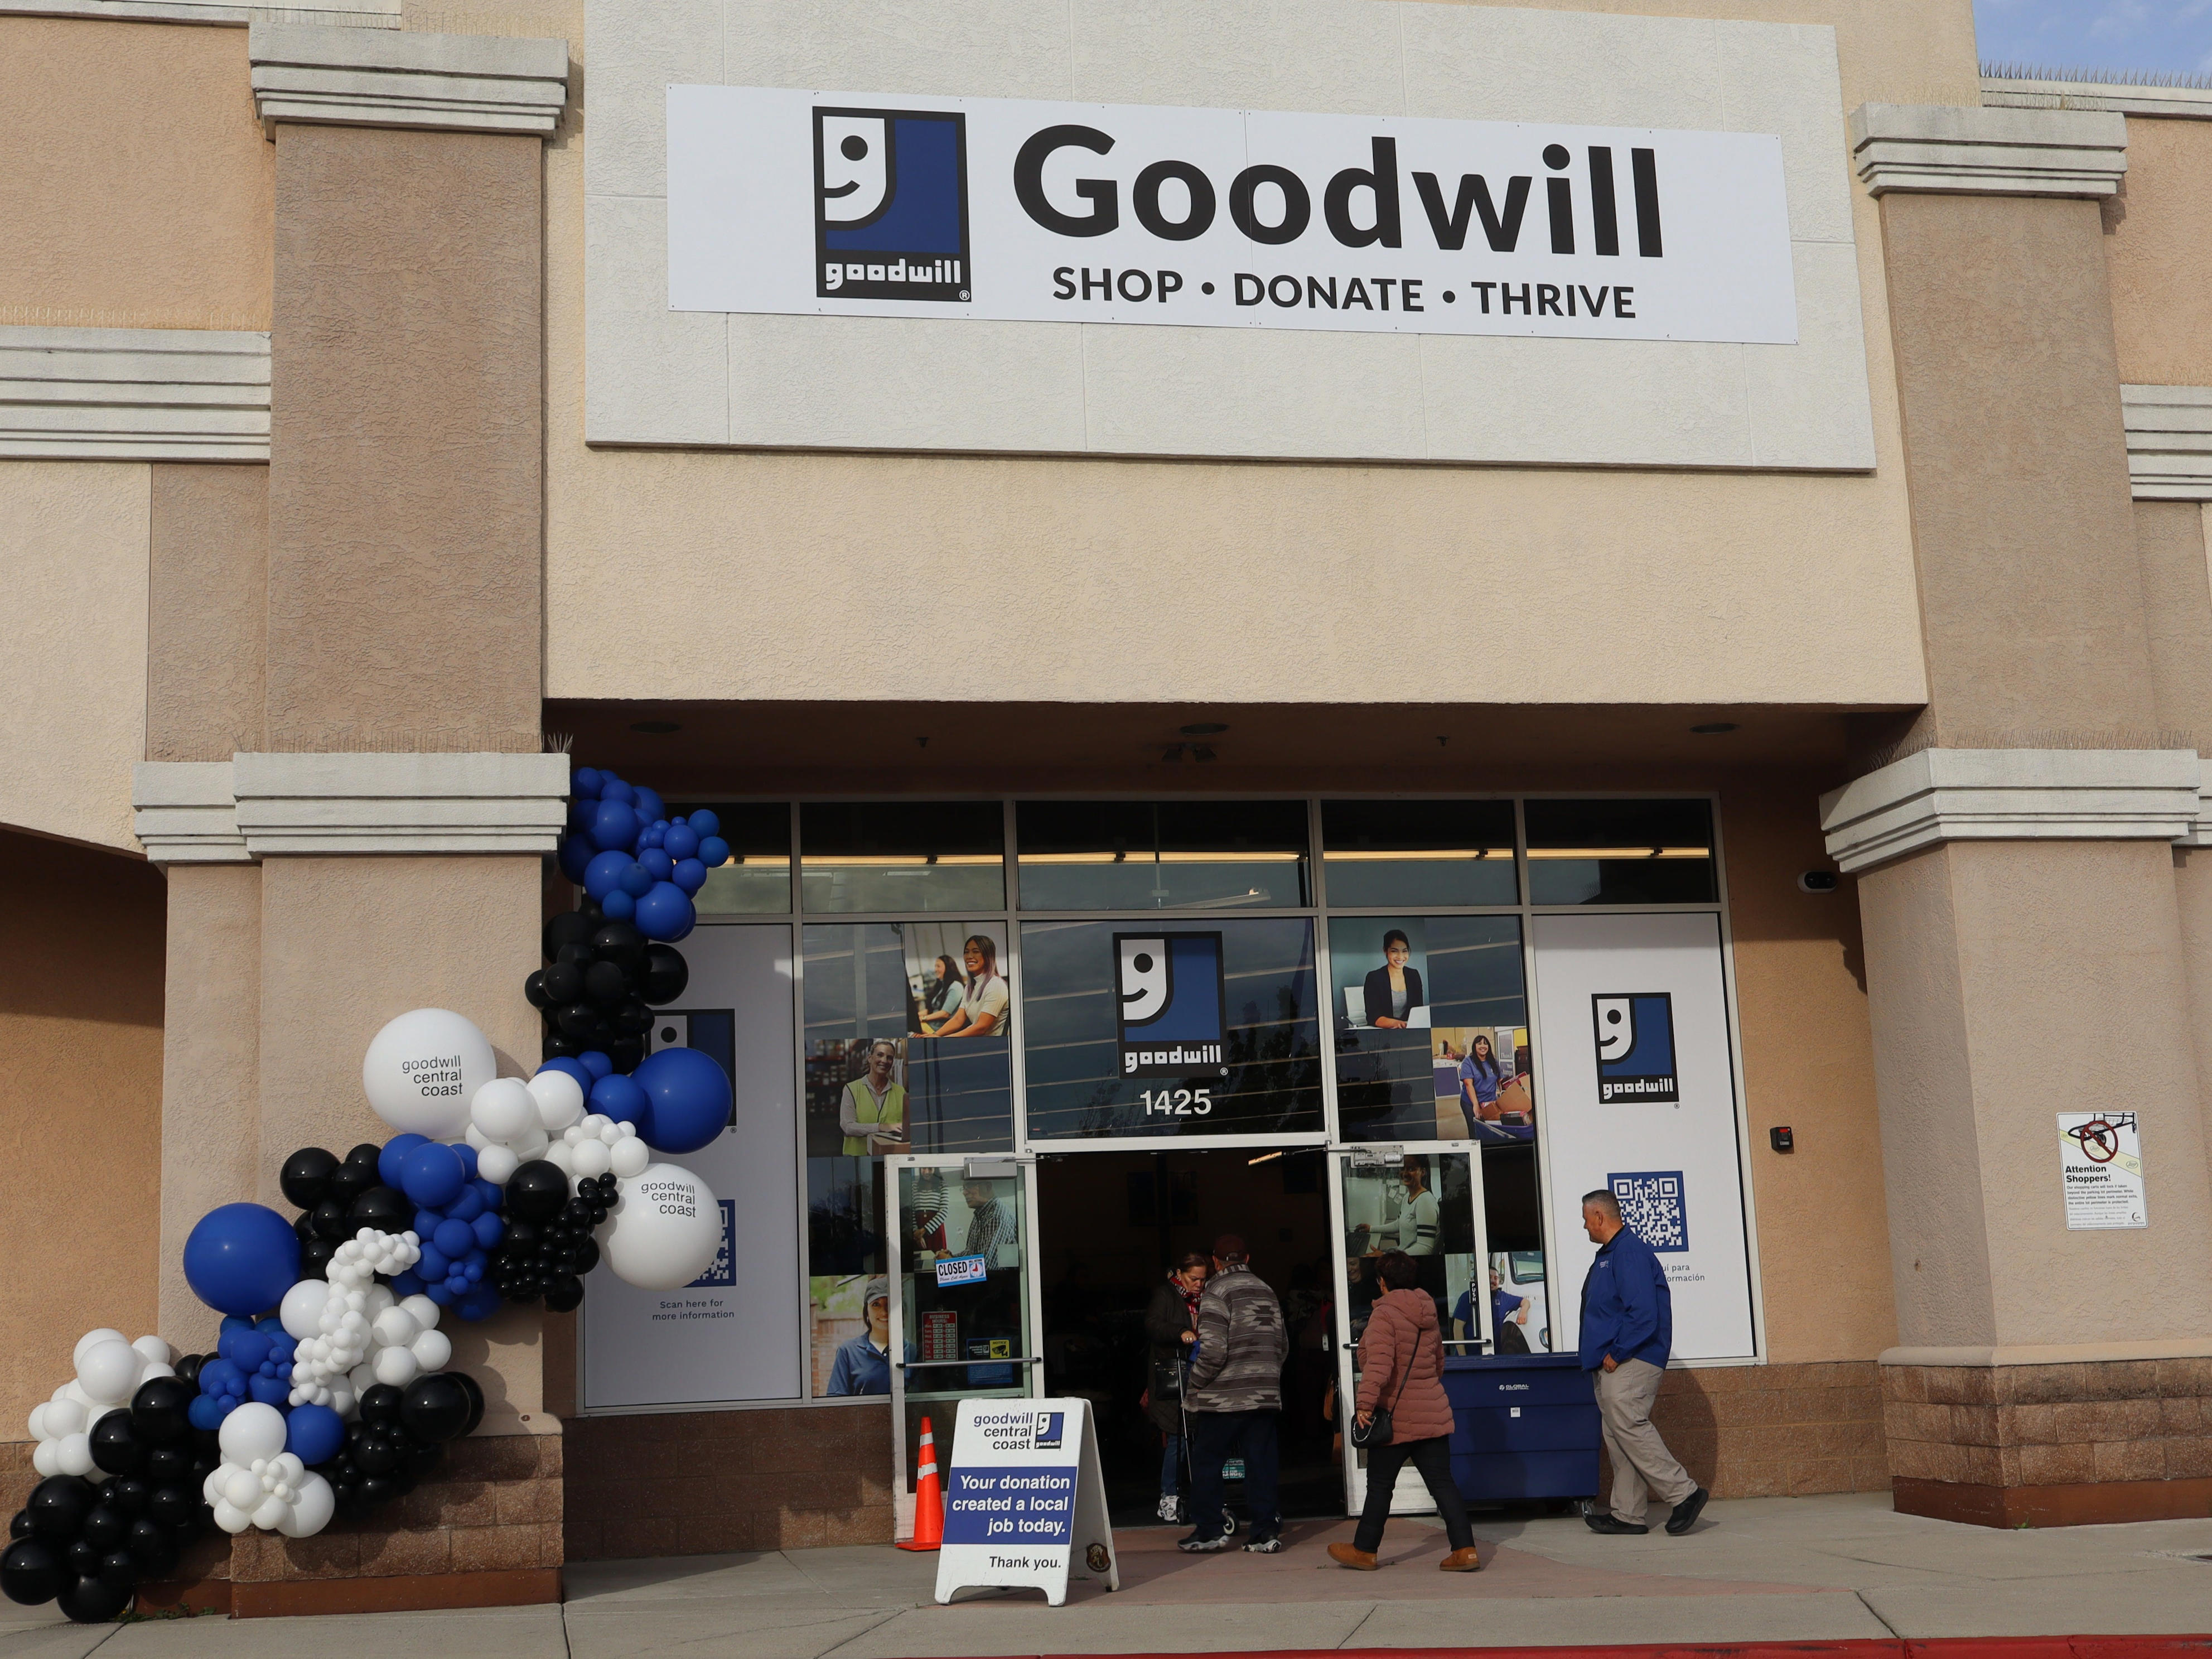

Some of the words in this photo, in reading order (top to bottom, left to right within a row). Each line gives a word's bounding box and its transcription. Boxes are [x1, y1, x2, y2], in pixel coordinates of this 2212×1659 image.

[1013, 124, 1663, 258] Goodwill
[825, 258, 961, 290] goodwill
[1053, 267, 1183, 303] SHOP
[1234, 273, 1424, 312] DONATE
[1471, 281, 1636, 319] THRIVE
[402, 1055, 461, 1074] goodwill
[1125, 1045, 1221, 1073] goodwill
[413, 1068, 461, 1084] central
[421, 1083, 462, 1096] coast
[1603, 1078, 1673, 1100] goodwill
[1139, 1088, 1211, 1116] 1425
[2065, 1165, 2107, 1173] Attention
[2066, 1174, 2111, 1183] Shoppers!
[641, 1181, 694, 1194] goodwill
[651, 1192, 695, 1205] central
[660, 1204, 696, 1218] coast
[938, 1261, 967, 1276] CLOSED
[1672, 1264, 1690, 1272] para
[1665, 1274, 1705, 1282] ormación
[680, 1310, 735, 1319] information
[974, 1412, 1033, 1427] goodwill
[984, 1425, 1032, 1437] central
[993, 1439, 1031, 1450] coast
[960, 1475, 996, 1489] Your
[999, 1475, 1070, 1489] donation
[952, 1496, 1012, 1511] created
[1016, 1499, 1025, 1511] a
[1030, 1496, 1069, 1511] local
[987, 1518, 1013, 1536] job
[1018, 1518, 1066, 1536] today.
[989, 1556, 1030, 1568] Thank
[1033, 1559, 1061, 1571] you.
